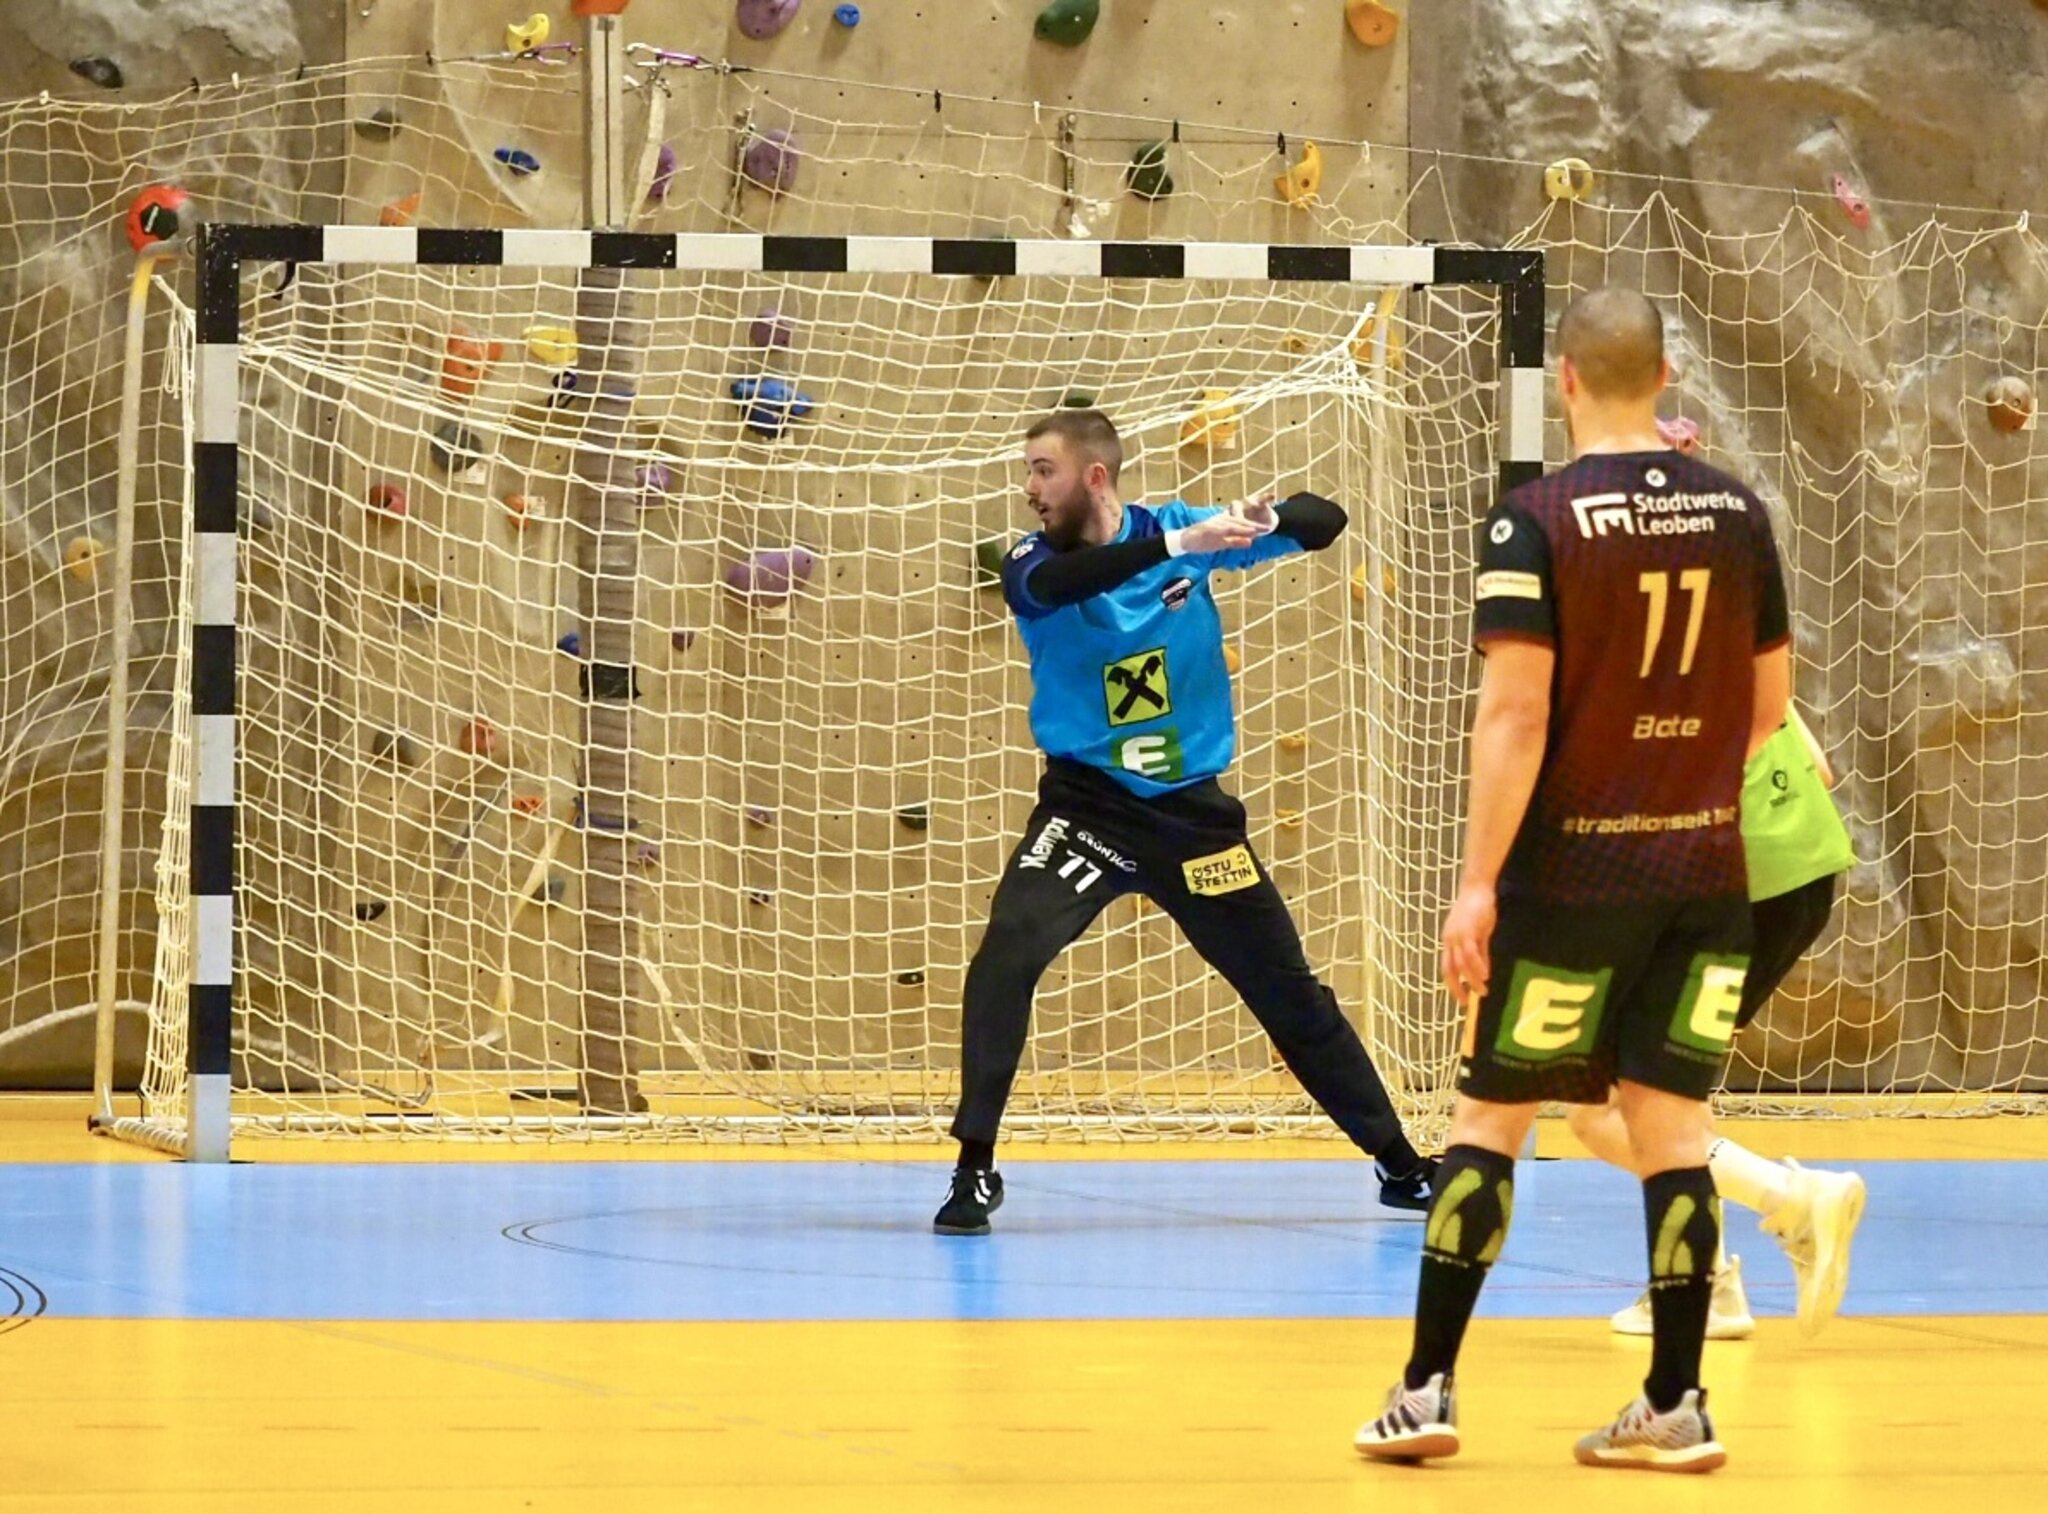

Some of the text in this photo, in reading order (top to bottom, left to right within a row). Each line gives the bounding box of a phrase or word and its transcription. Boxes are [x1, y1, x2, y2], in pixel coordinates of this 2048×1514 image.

[1632, 492, 1747, 513] Stadtwerke
[1636, 515, 1715, 536] Leoben
[1121, 735, 1171, 777] E
[1194, 865, 1252, 890] STETTIN
